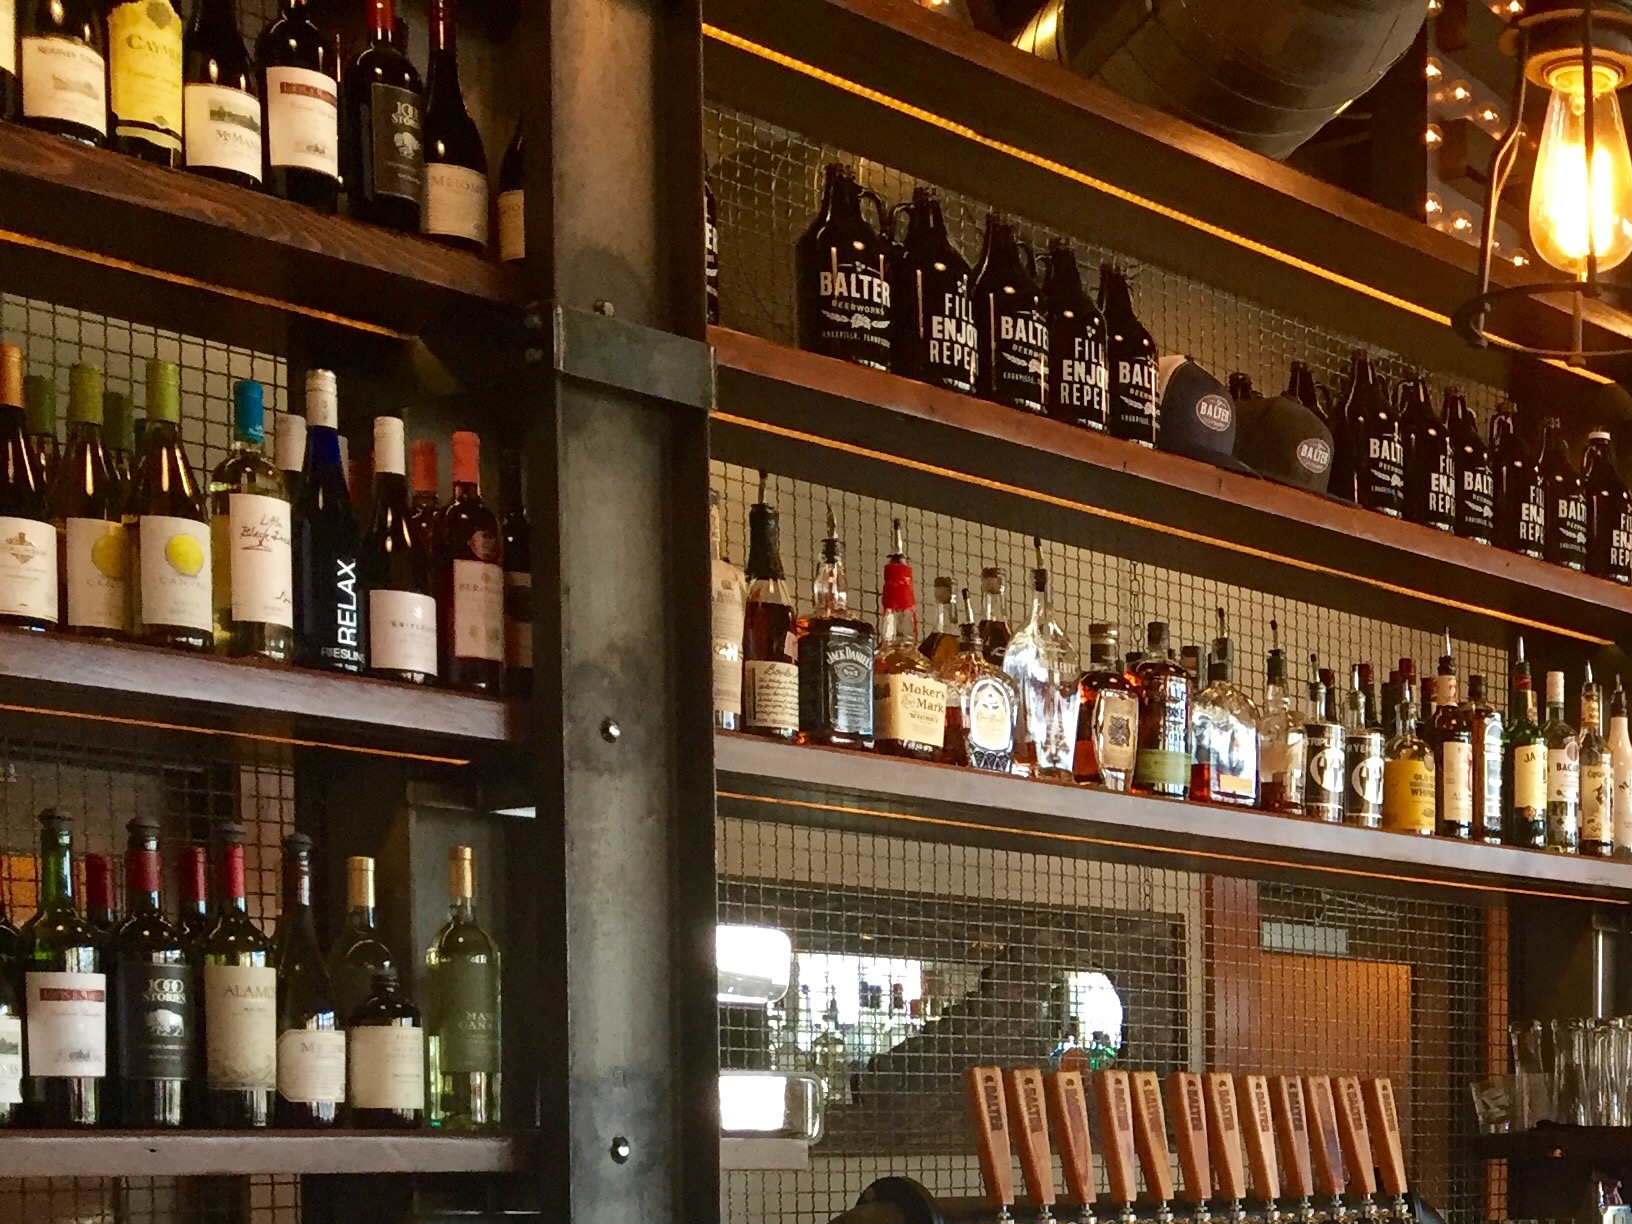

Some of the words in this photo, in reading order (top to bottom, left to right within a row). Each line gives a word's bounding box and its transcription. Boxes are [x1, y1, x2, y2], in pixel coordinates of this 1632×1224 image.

[819, 271, 891, 308] BALTER
[945, 293, 974, 324] FILL
[1001, 315, 1050, 354] BALTE
[929, 340, 979, 376] REPEA
[1118, 361, 1160, 394] BALT
[1199, 401, 1230, 423] BALTER
[1300, 444, 1329, 465] BALTER
[1463, 470, 1494, 498] BALT
[1558, 499, 1588, 525] BALT
[337, 559, 357, 647] RELAX
[826, 649, 846, 665] JACK
[901, 681, 945, 699] Maker's
[916, 697, 944, 714] Mark
